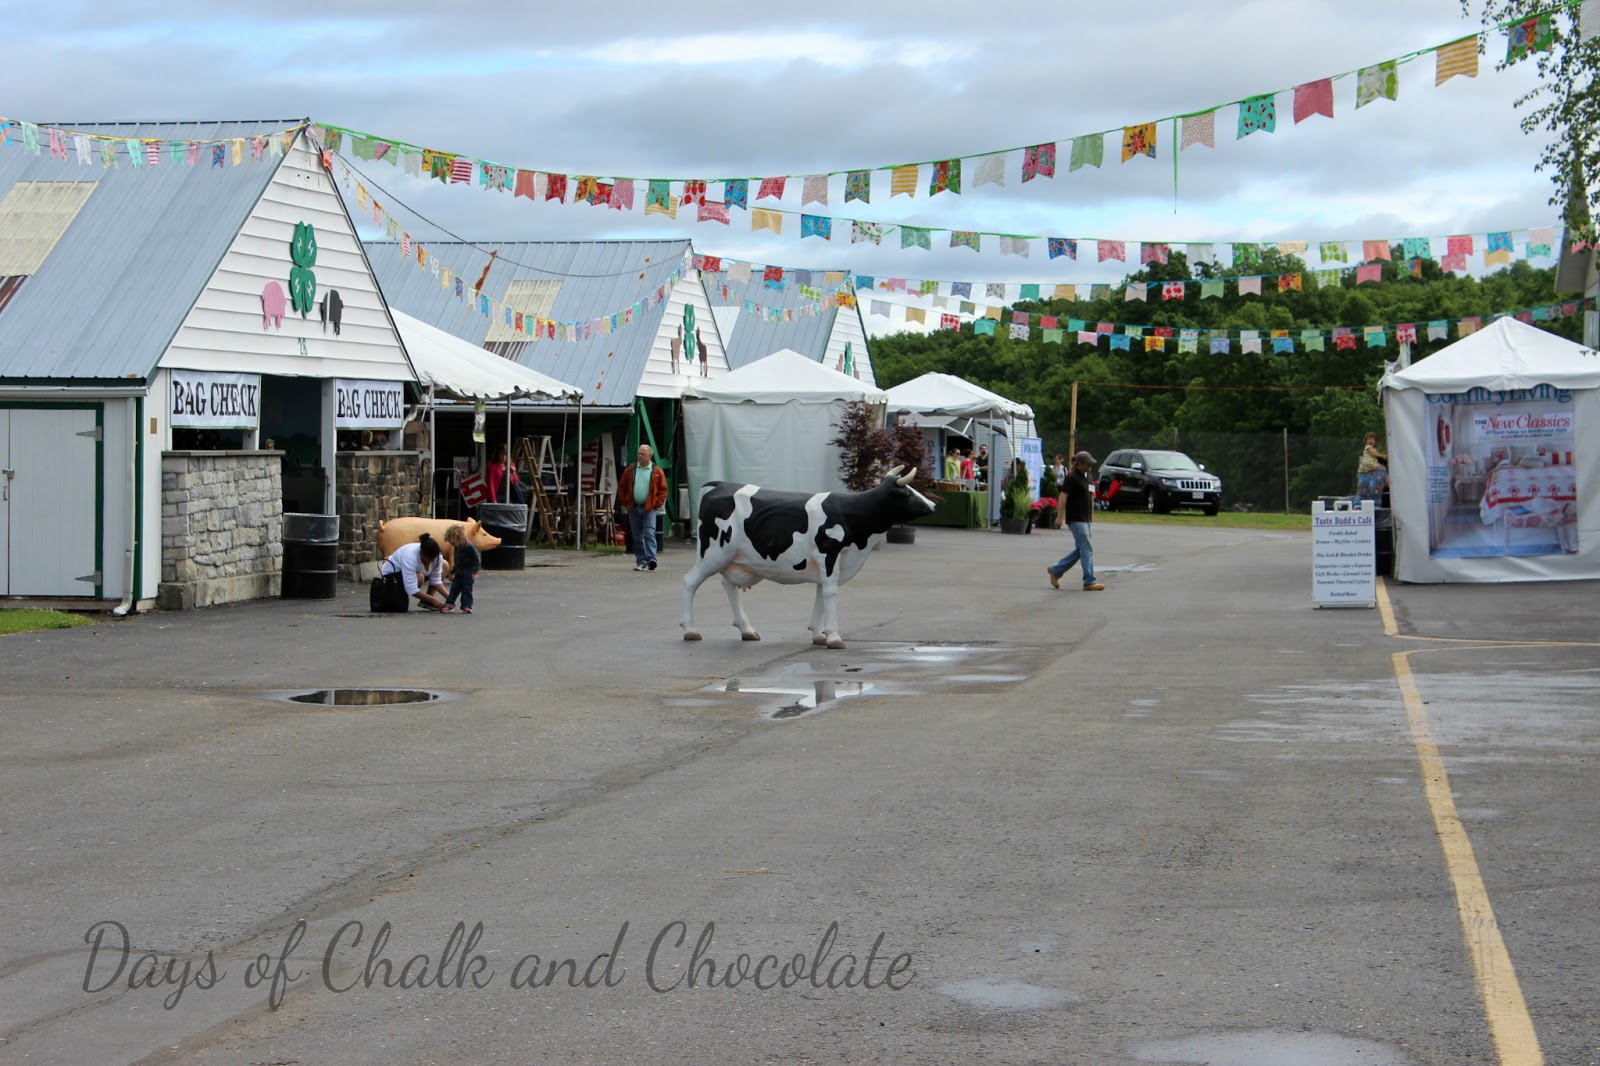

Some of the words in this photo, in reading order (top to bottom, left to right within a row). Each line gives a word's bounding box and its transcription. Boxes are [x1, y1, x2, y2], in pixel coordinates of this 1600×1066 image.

[173, 380, 207, 416] BAG
[210, 381, 257, 417] CHECK
[337, 388, 361, 418] BAG
[363, 389, 401, 419] CHECK
[1482, 413, 1516, 430] New
[1517, 413, 1571, 429] Classics
[461, 473, 487, 506] 5
[1315, 517, 1333, 525] Taste
